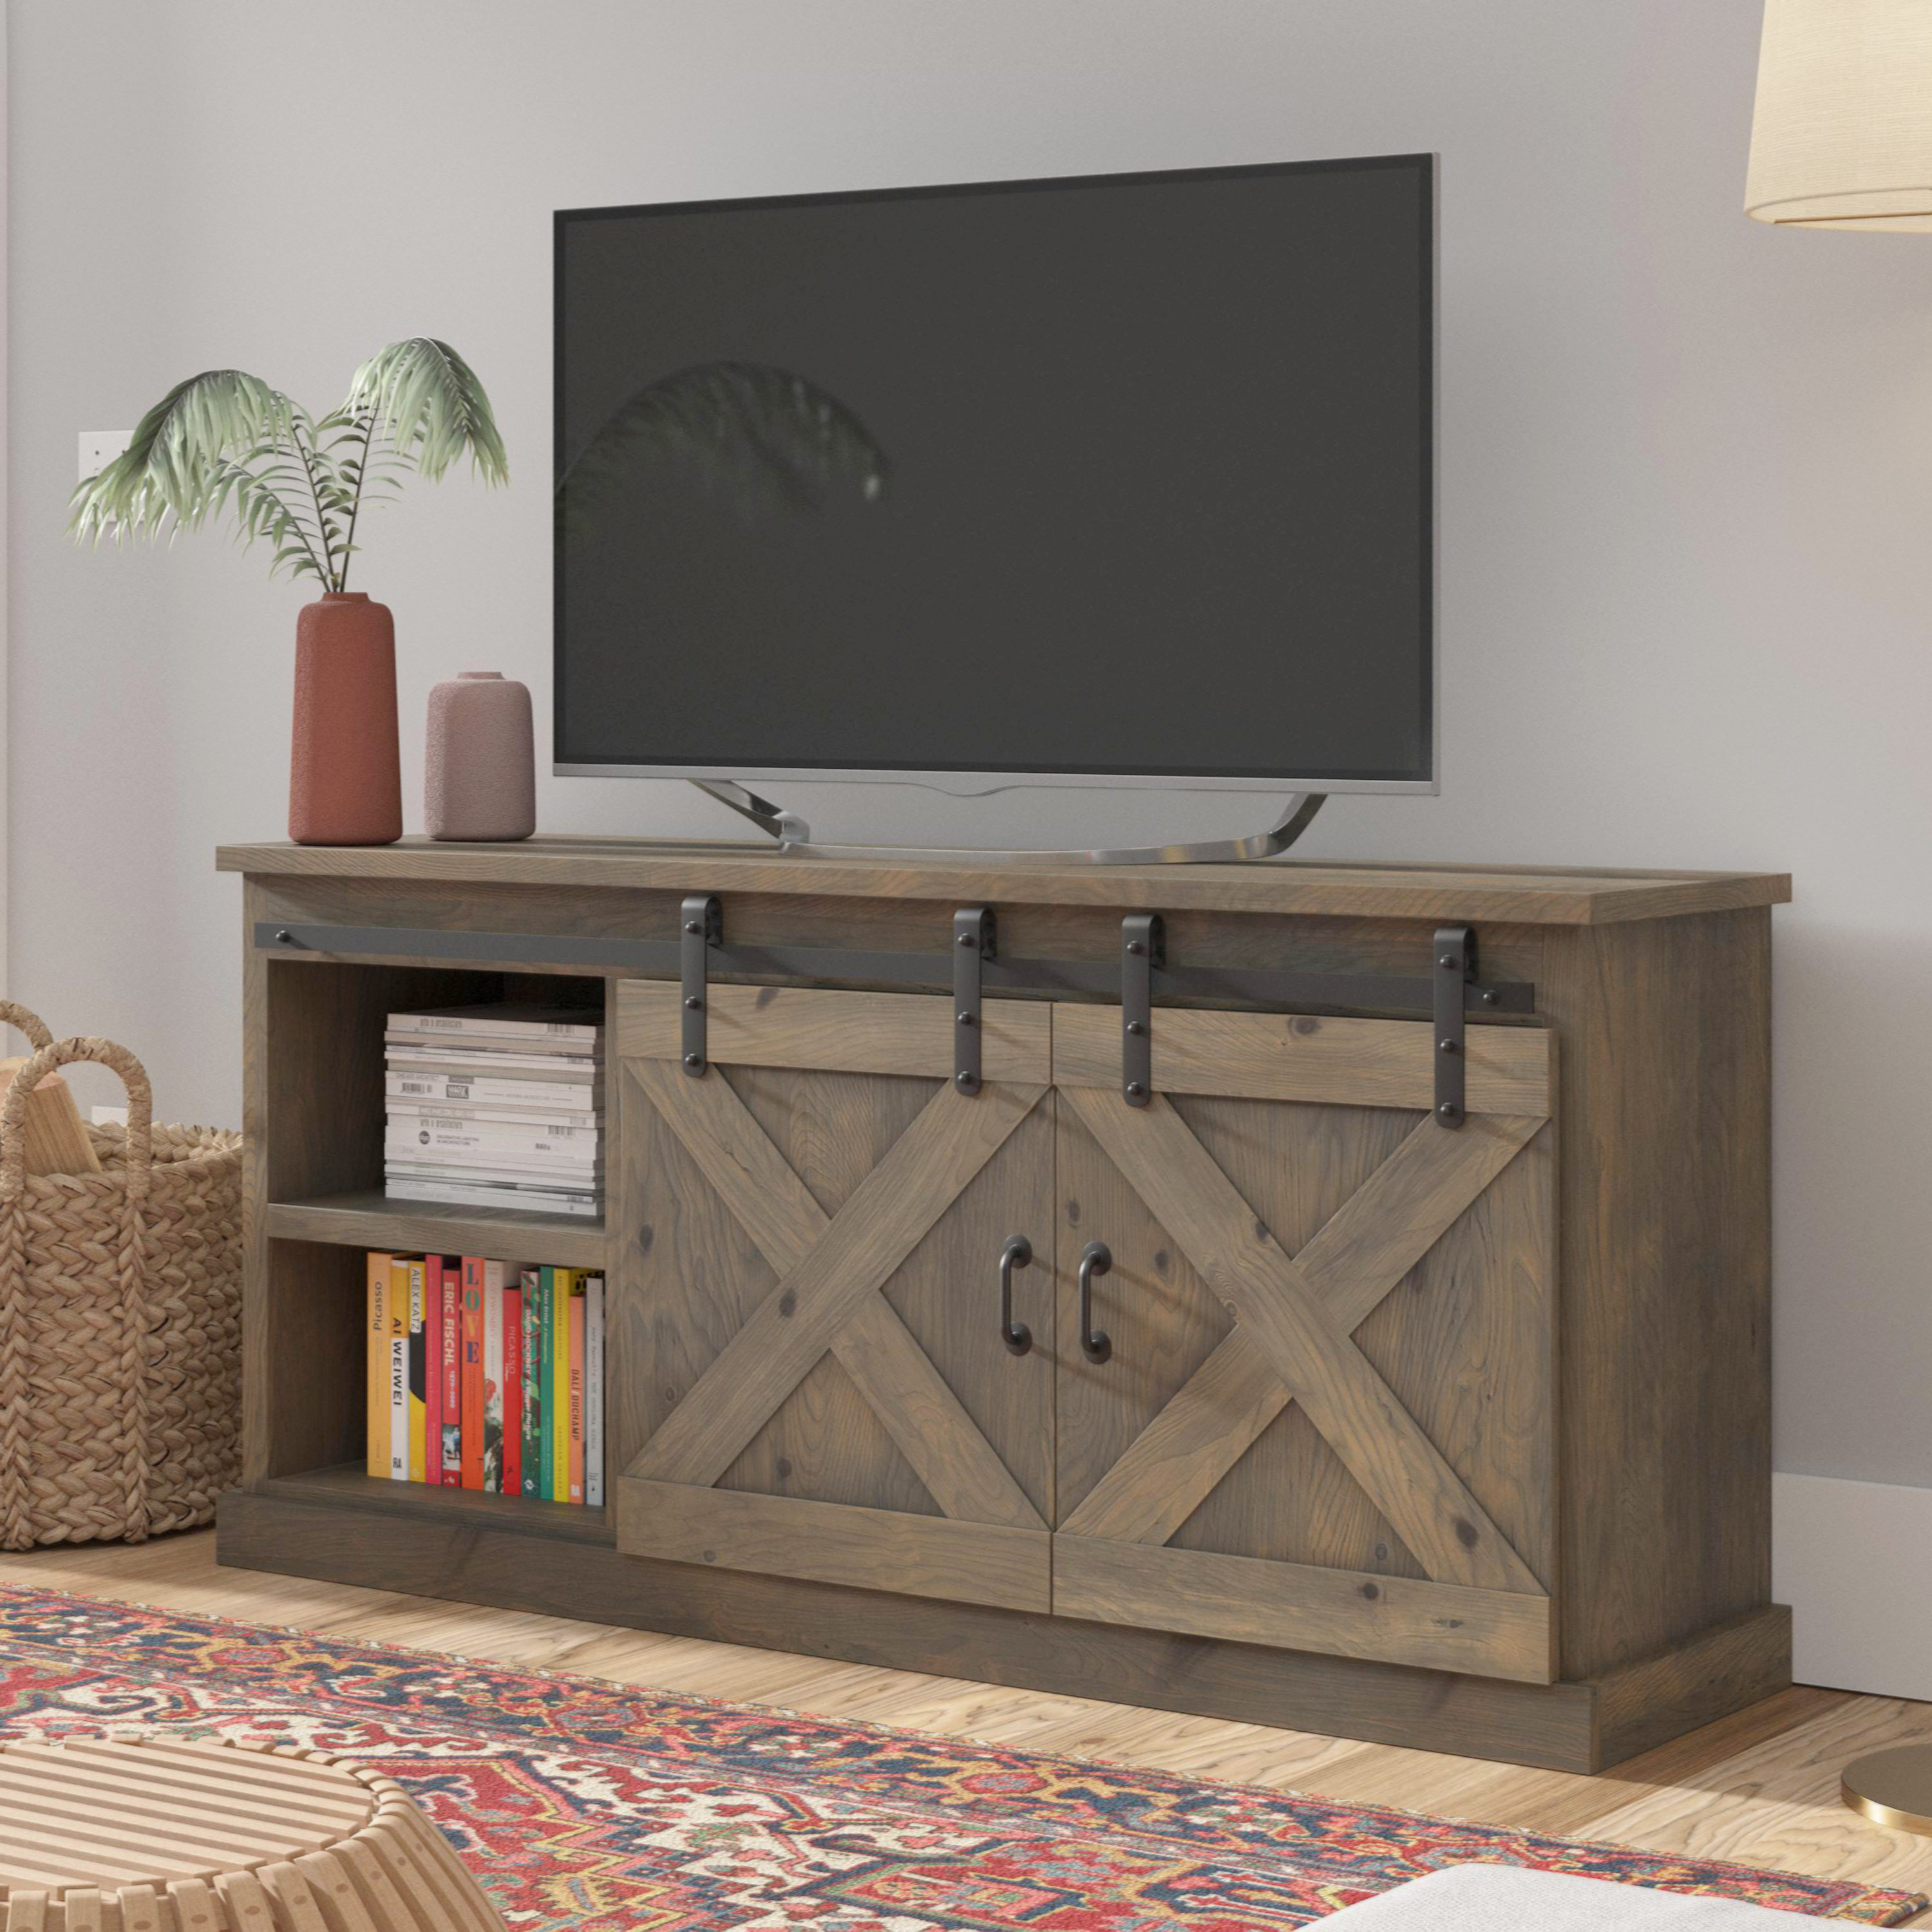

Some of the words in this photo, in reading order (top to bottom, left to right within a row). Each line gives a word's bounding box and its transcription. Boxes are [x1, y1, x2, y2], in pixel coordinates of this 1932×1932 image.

[412, 1269, 420, 1298] ALEX
[444, 1282, 455, 1312] ERIC
[373, 1282, 383, 1331] Picasso
[392, 1317, 402, 1334] AI
[412, 1302, 420, 1331] KATZ
[444, 1318, 455, 1366] FISCHL
[508, 1326, 516, 1375] PICASSO
[392, 1341, 402, 1406] WEIWEI
